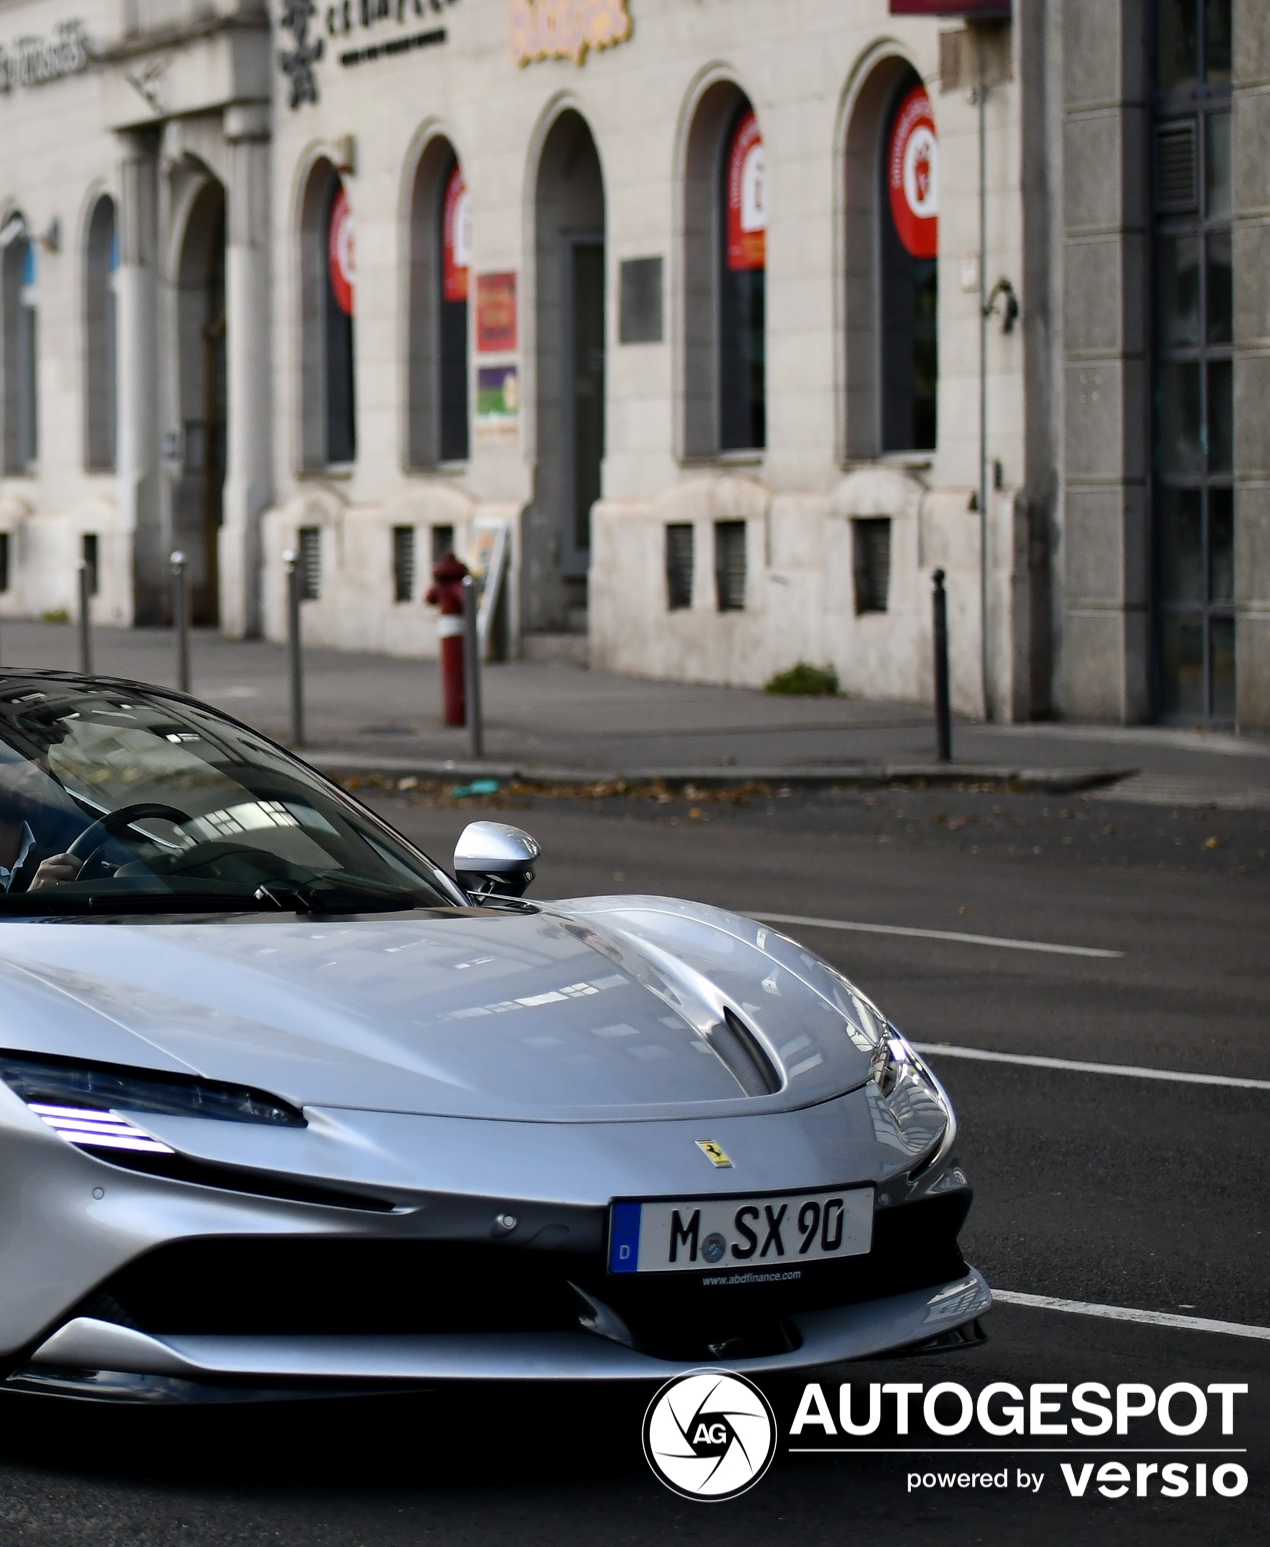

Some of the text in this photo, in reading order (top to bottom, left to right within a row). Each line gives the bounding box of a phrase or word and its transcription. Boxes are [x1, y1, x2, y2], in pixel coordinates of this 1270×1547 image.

[619, 1198, 845, 1262] D M SX 90
[701, 1269, 802, 1286] www.abdfinance.com
